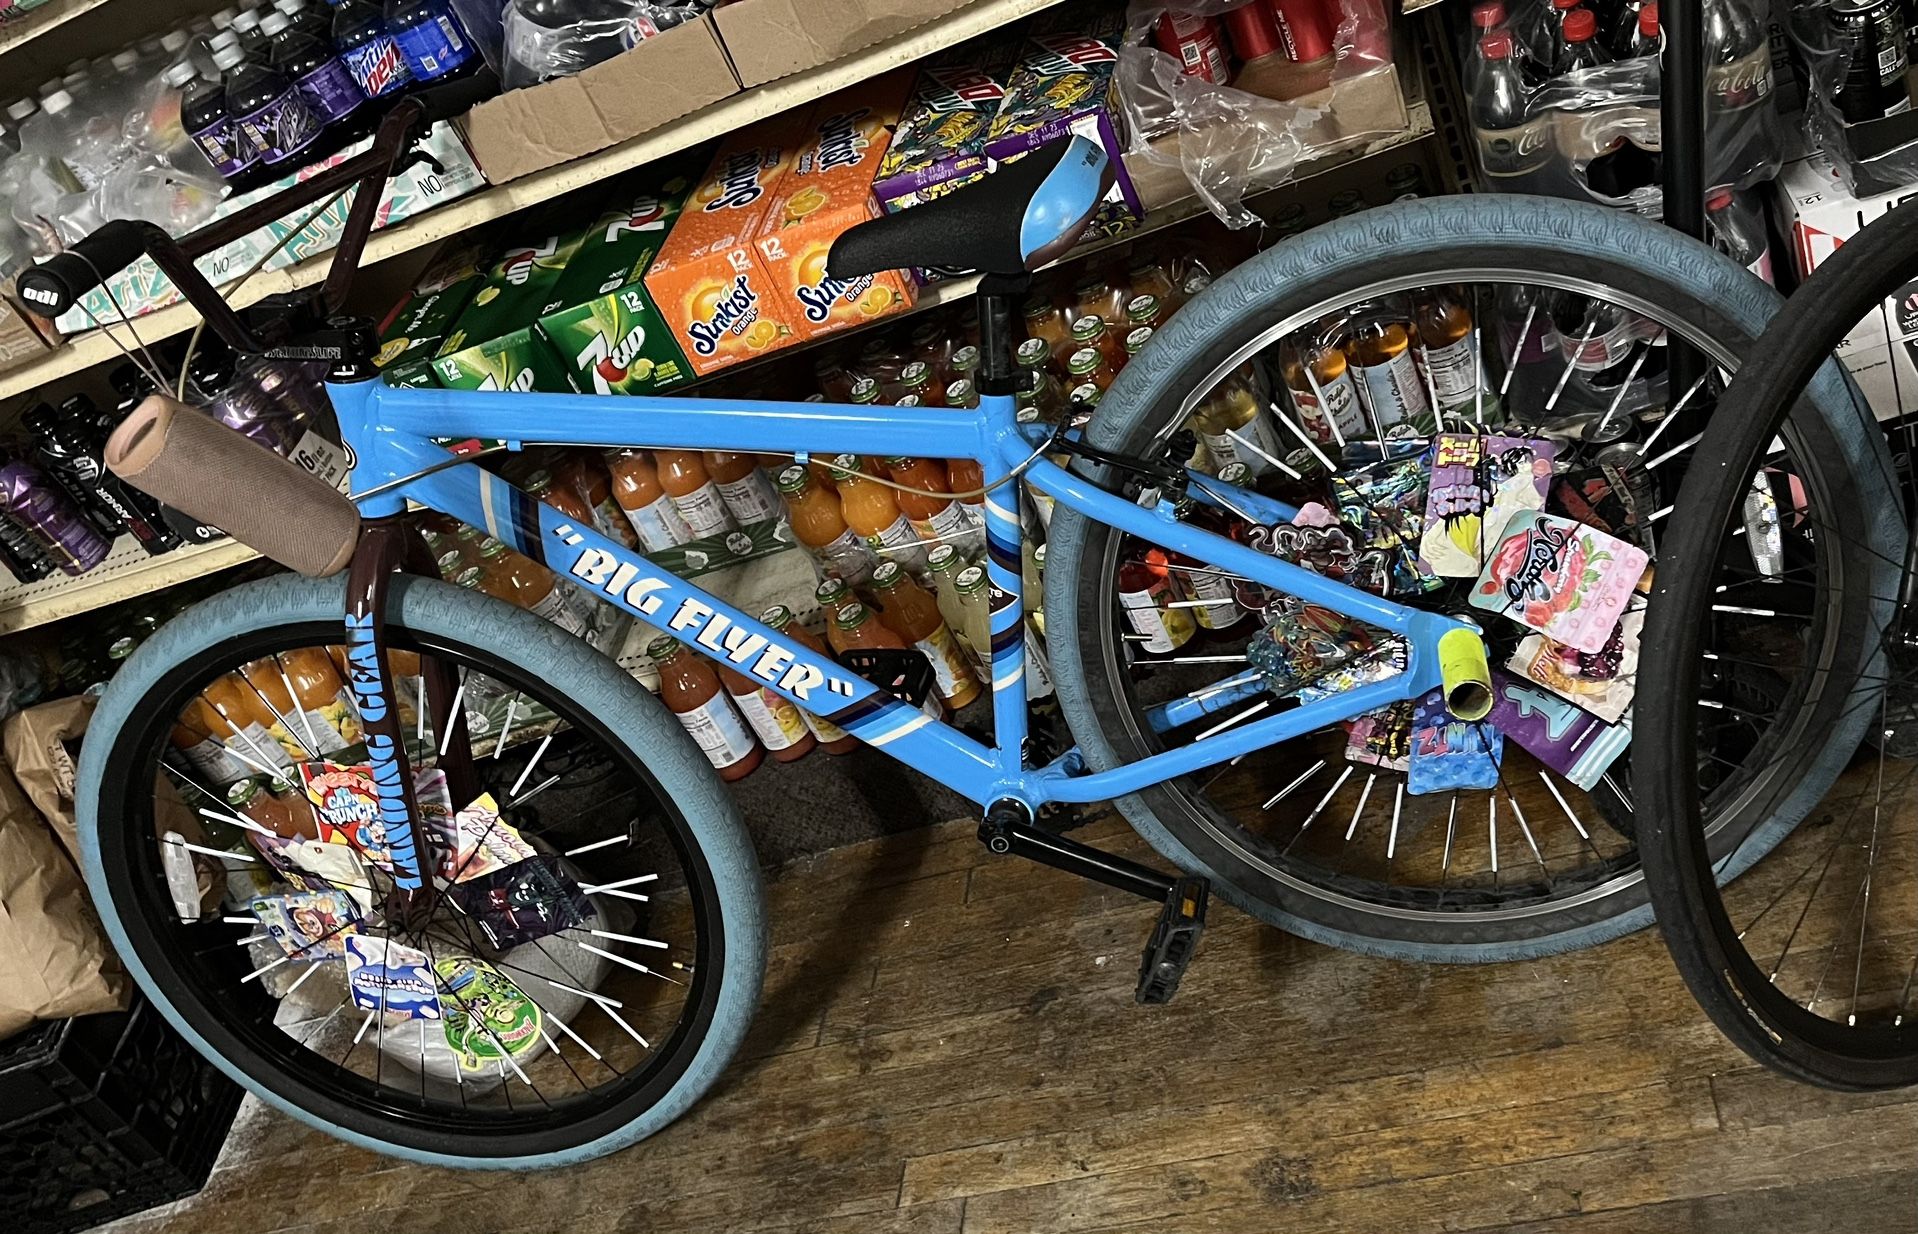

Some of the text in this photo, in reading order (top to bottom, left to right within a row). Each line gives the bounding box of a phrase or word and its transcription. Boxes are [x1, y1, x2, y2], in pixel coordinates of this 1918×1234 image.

[1281, 22, 1299, 61] RECYCLE
[417, 174, 443, 197] NO
[727, 249, 748, 267] 12
[760, 237, 783, 256] 12
[212, 256, 230, 277] NO
[620, 291, 643, 309] 12
[845, 273, 874, 303] Orange
[687, 274, 759, 356] Sunkist
[731, 307, 759, 336] Orange
[439, 358, 462, 381] 12
[344, 611, 423, 891] LANDING GEAR
[1417, 722, 1496, 757] RUNTZ
[319, 802, 378, 826] CRUNCH
